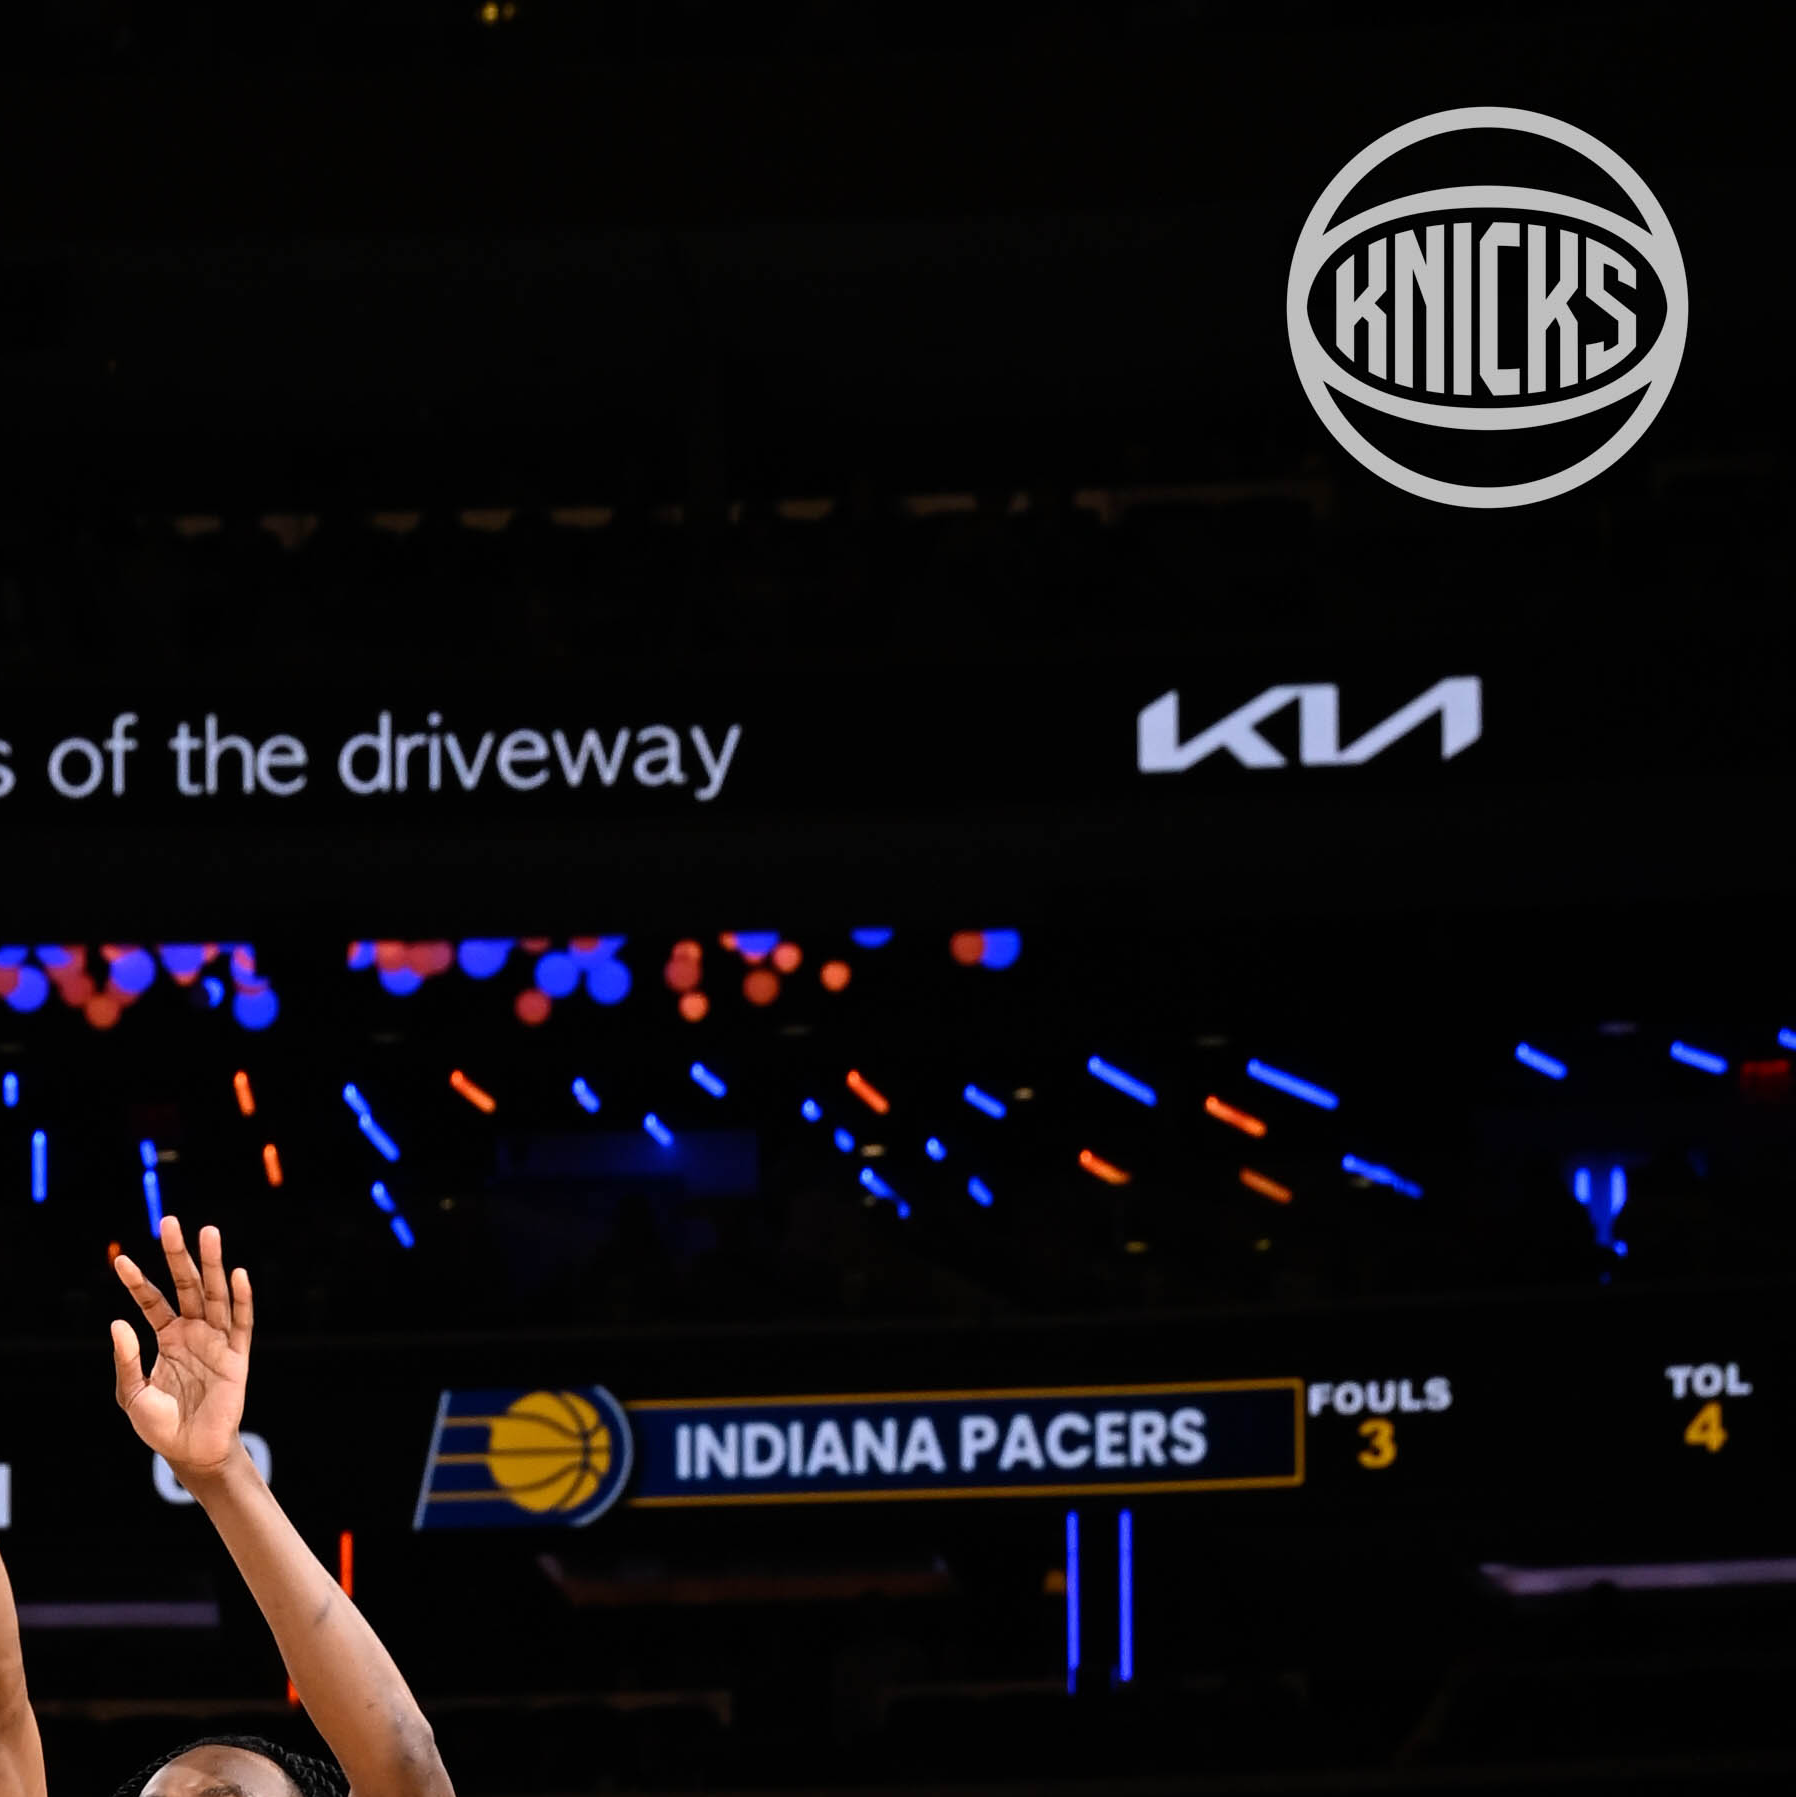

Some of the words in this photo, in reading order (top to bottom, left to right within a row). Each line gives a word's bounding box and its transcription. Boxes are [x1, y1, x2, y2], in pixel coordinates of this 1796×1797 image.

[47, 712, 138, 799] of
[169, 714, 308, 796] the
[337, 711, 741, 801] driveway
[1307, 1376, 1453, 1416] FOULS
[1665, 1363, 1752, 1399] TOL
[676, 1417, 946, 1479] INDIANA
[960, 1408, 1207, 1471] PACERS
[1358, 1418, 1398, 1469] 3
[1684, 1401, 1728, 1453] 4
